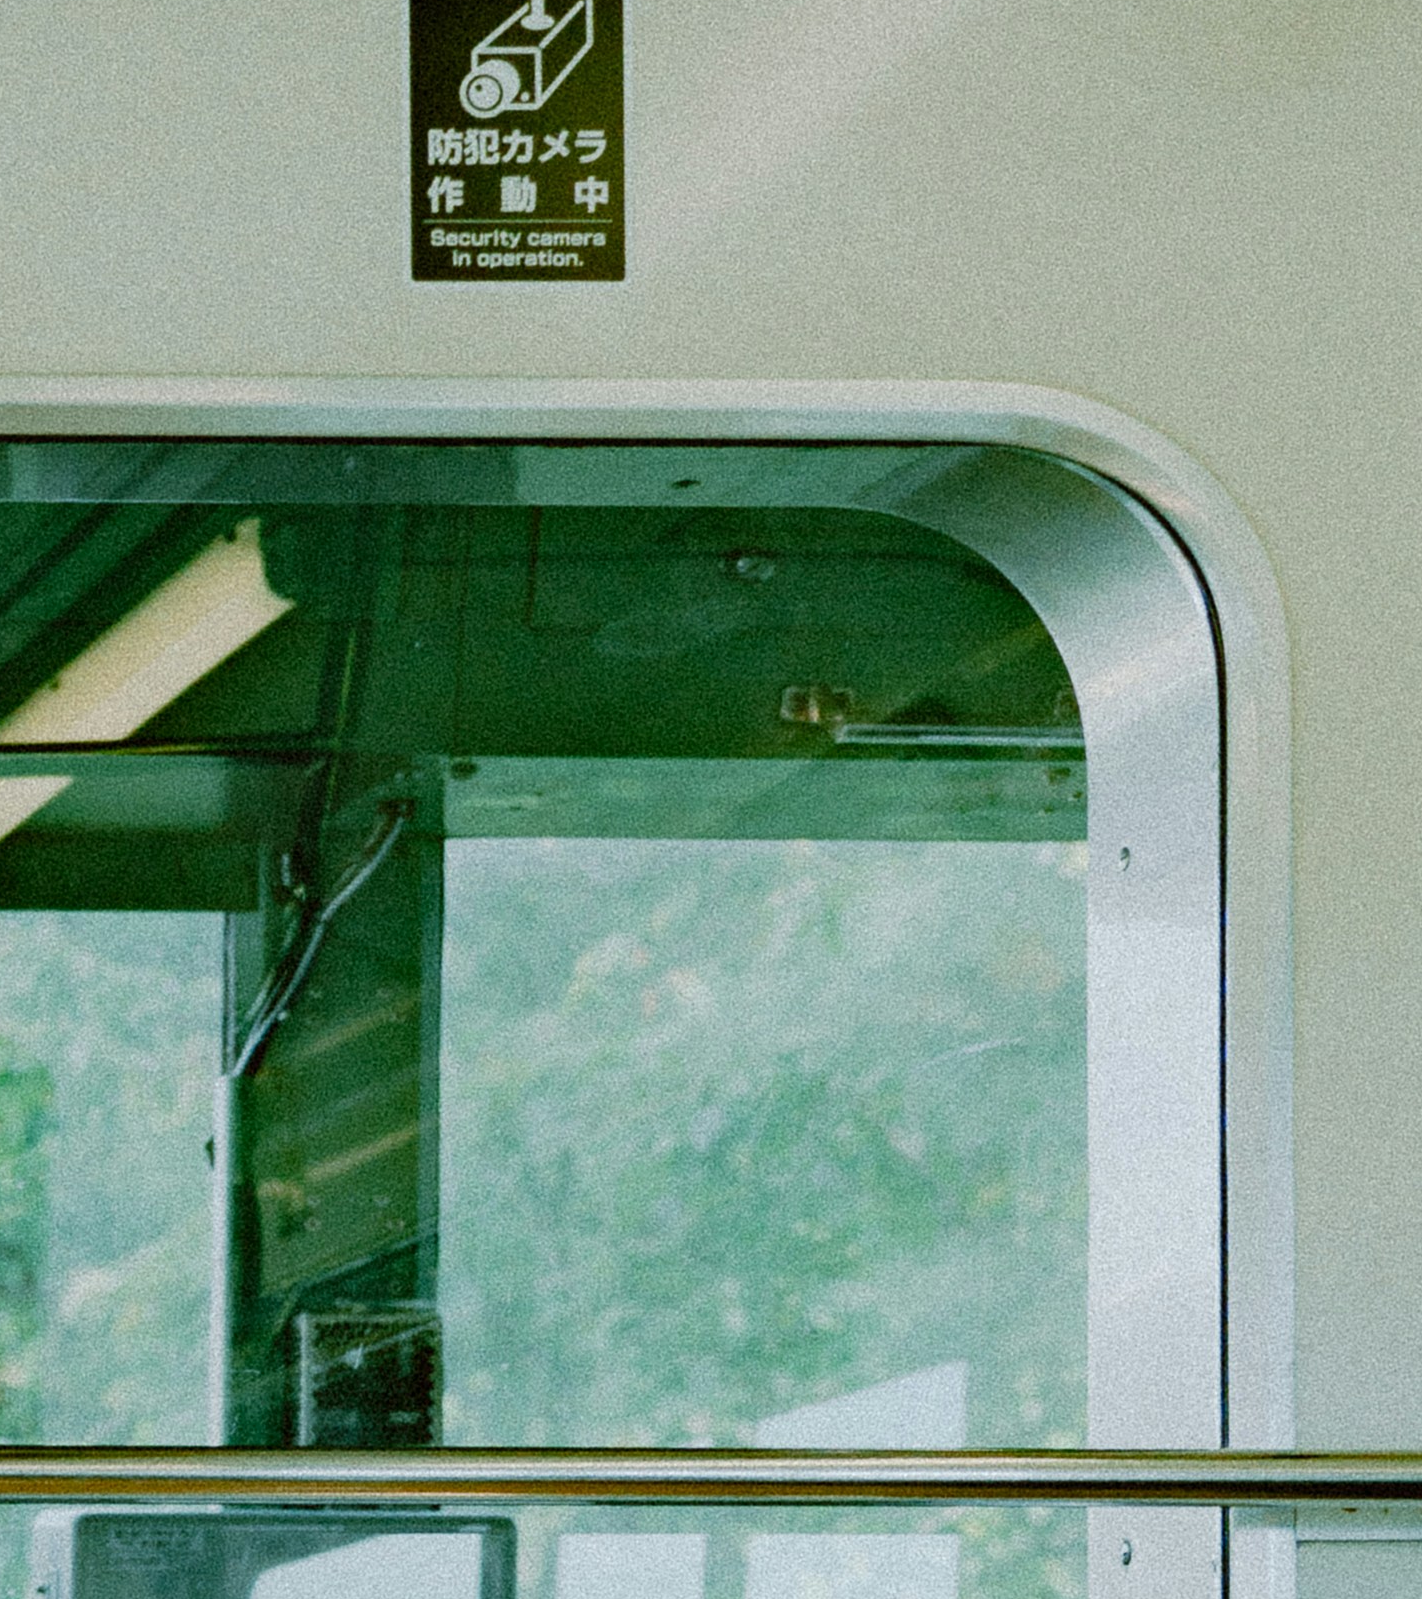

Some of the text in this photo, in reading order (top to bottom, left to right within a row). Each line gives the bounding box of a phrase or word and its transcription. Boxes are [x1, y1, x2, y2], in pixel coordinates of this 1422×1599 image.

[427, 128, 607, 165] 防犯カメラ
[430, 228, 606, 248] Security camera
[452, 250, 584, 268] in operation.
